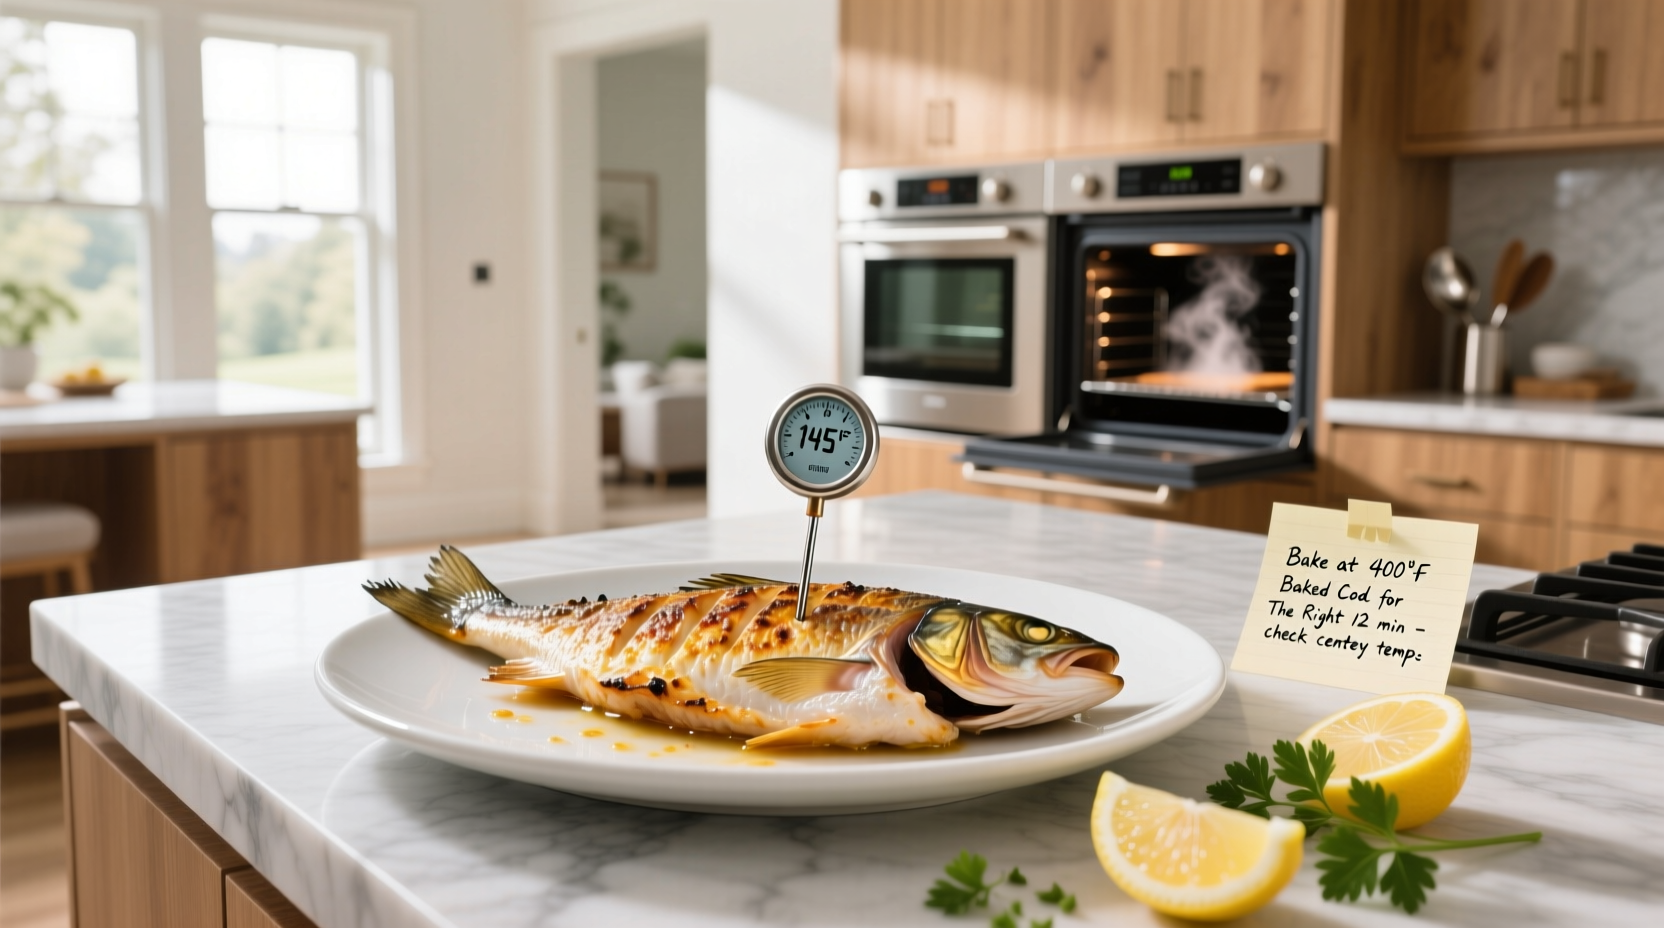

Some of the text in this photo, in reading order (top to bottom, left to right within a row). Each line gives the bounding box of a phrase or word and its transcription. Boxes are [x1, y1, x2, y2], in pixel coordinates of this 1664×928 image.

[1286, 546, 1328, 569] Bake
[1337, 557, 1358, 572] at
[1280, 575, 1403, 609] Baked Cod for
[1269, 601, 1293, 617] The
[1303, 604, 1344, 629] Right
[1352, 613, 1368, 627] 12
[1376, 619, 1405, 634] min
[1265, 624, 1307, 643] check
